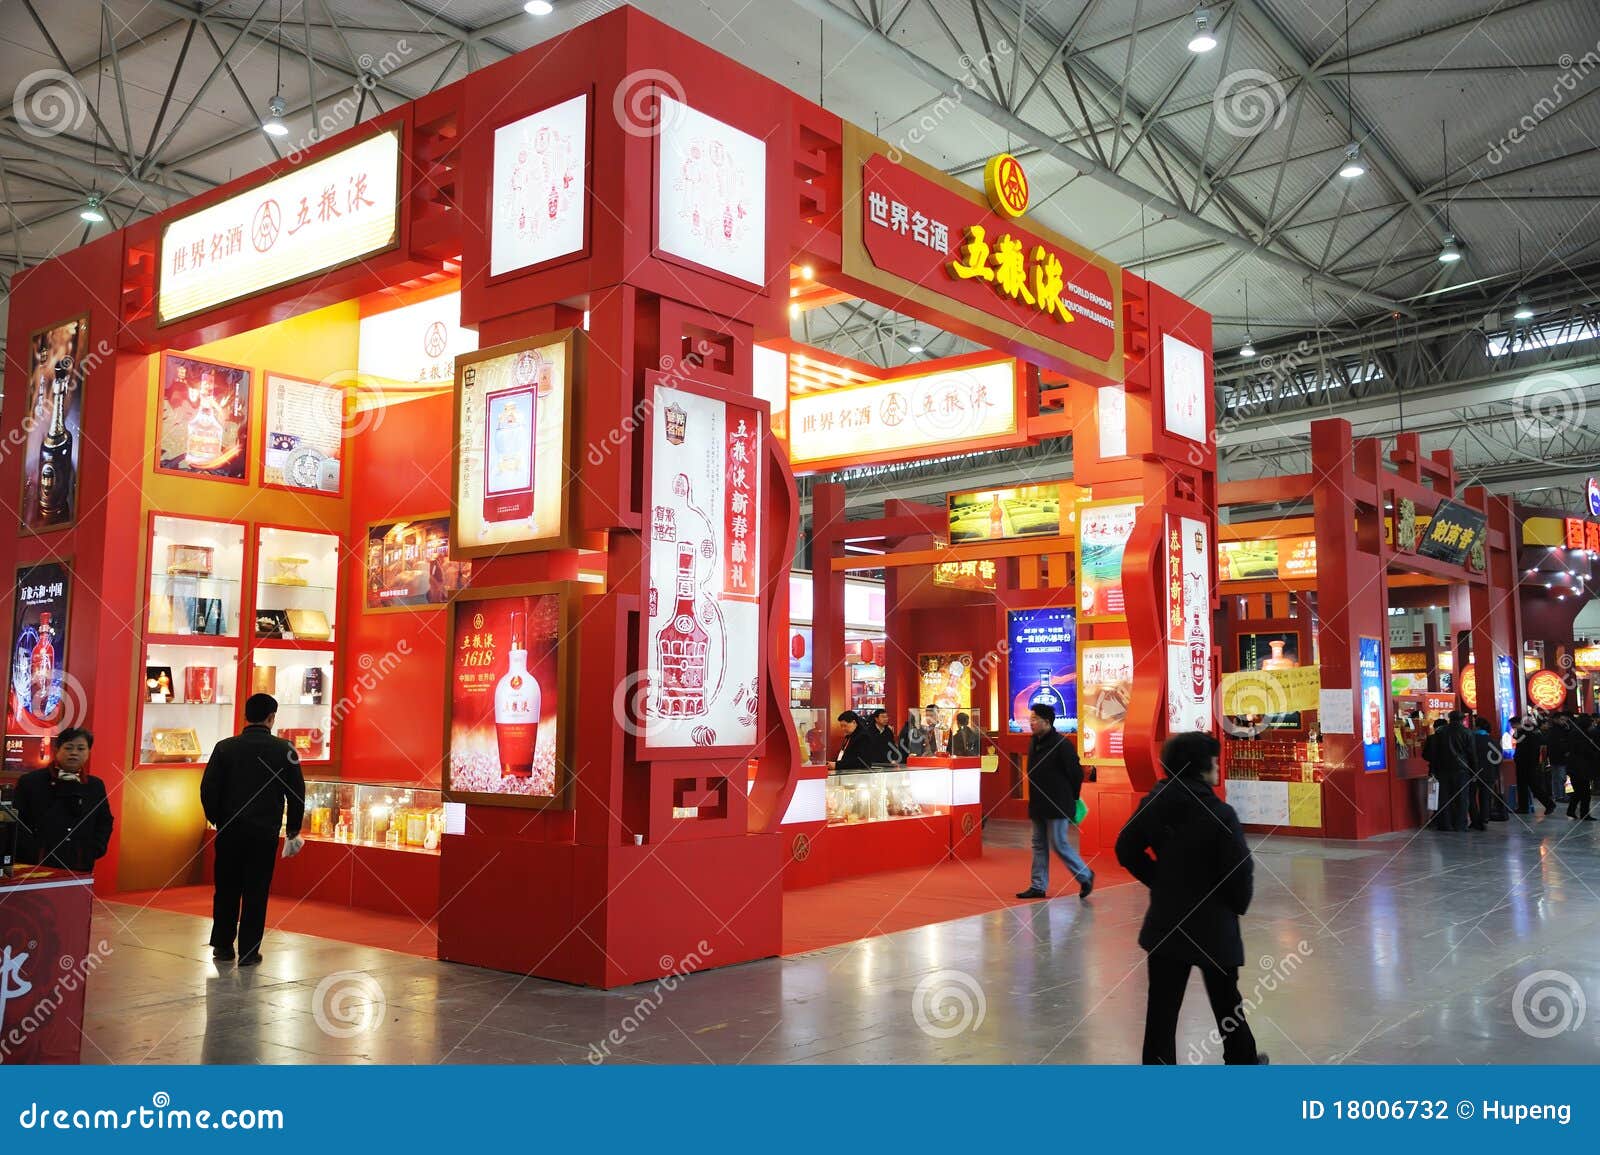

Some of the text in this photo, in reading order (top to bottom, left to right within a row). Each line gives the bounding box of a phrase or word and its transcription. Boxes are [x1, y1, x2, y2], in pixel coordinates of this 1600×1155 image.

[173, 173, 376, 276] 世界名酒 五粮液
[868, 191, 1075, 323] 世界名酒 五粮液
[1067, 281, 1113, 311] WORLD FAMOUS
[802, 404, 871, 434] 世界名酒
[730, 419, 752, 589] 五粮液新春献礼
